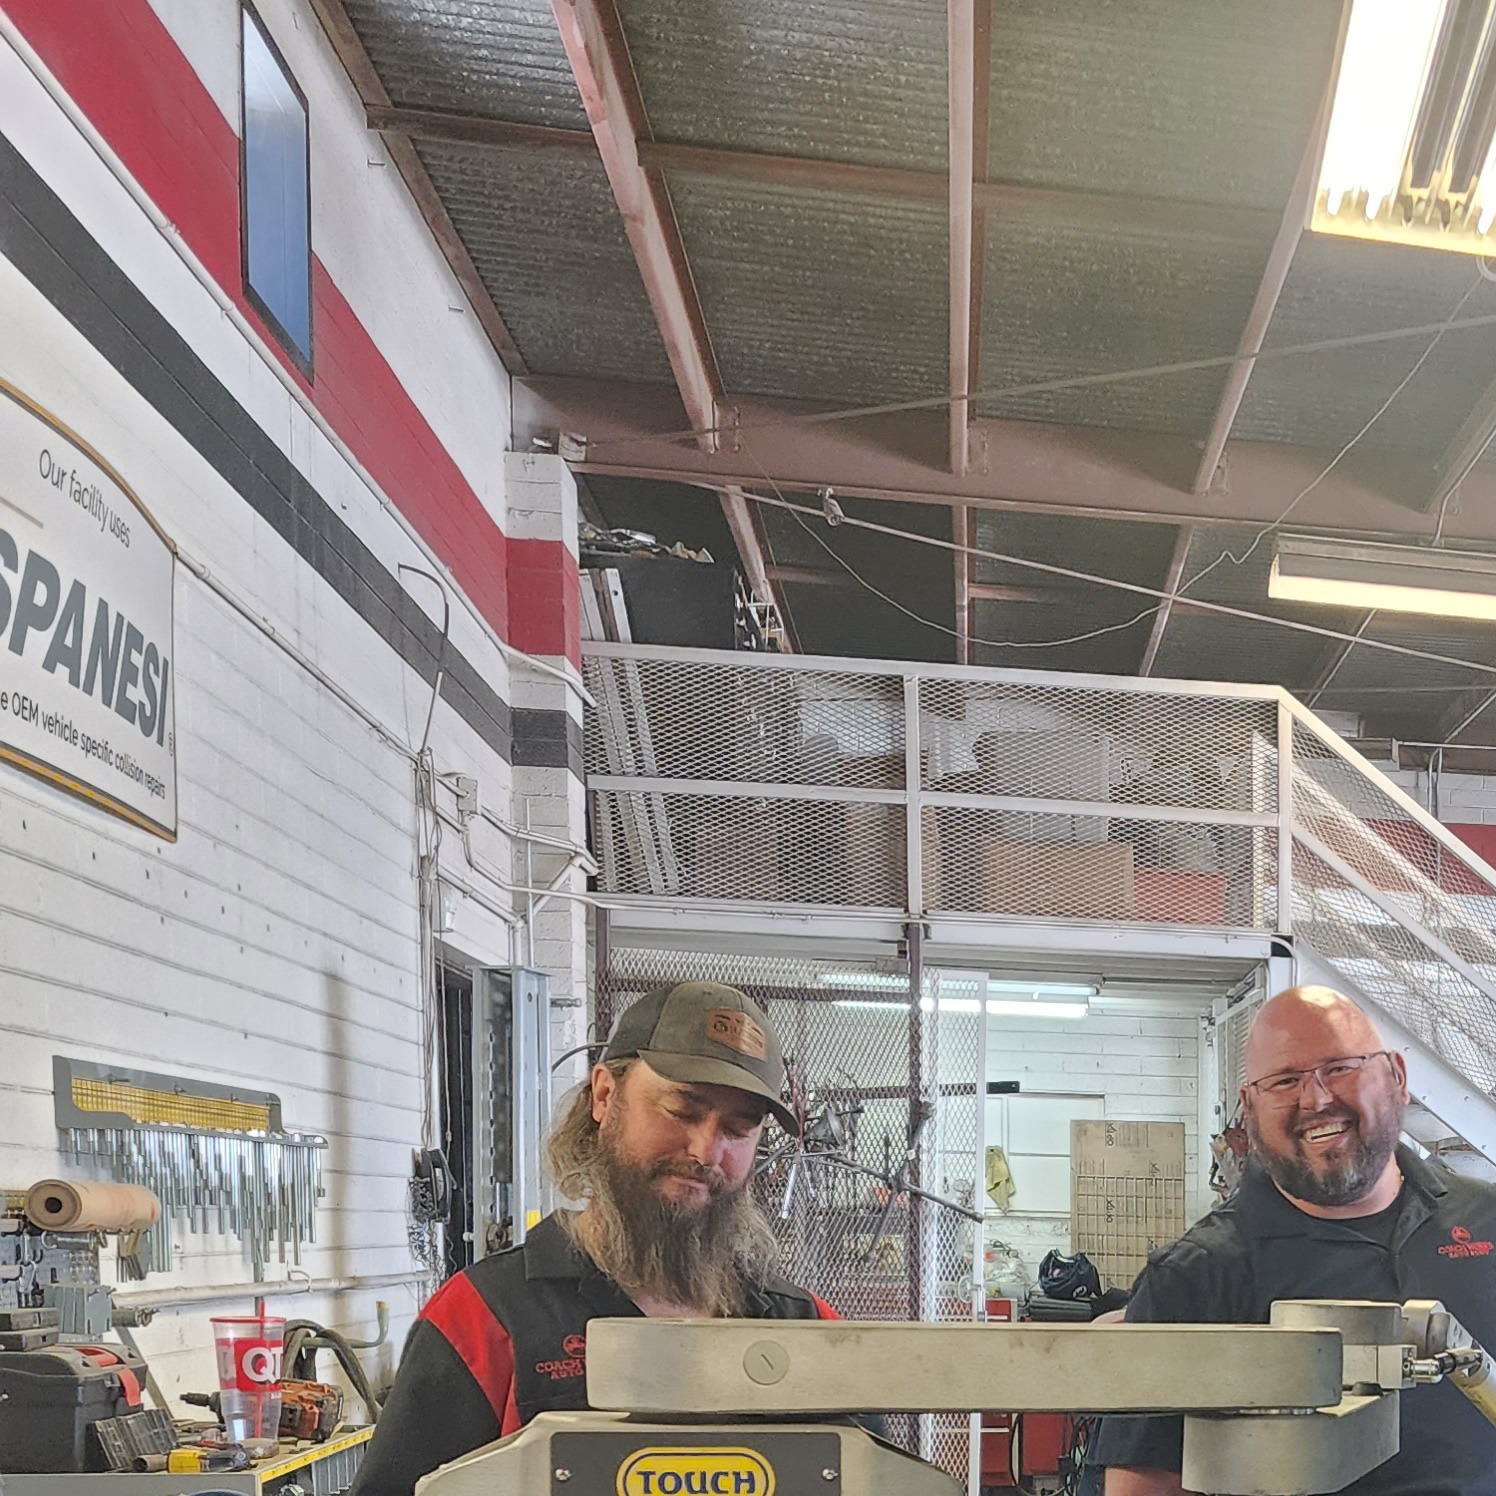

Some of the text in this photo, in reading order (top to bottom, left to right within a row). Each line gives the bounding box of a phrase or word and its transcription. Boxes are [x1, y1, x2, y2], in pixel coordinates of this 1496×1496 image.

[39, 448, 131, 549] Our facility uses
[12, 691, 39, 728] OEM
[42, 711, 79, 747] vehicle
[80, 732, 114, 767] specific
[114, 752, 144, 785] collision
[144, 772, 166, 800] repairs
[241, 1346, 283, 1384] QT
[535, 1359, 583, 1373] COACH
[636, 1470, 756, 1495] TOUCH
